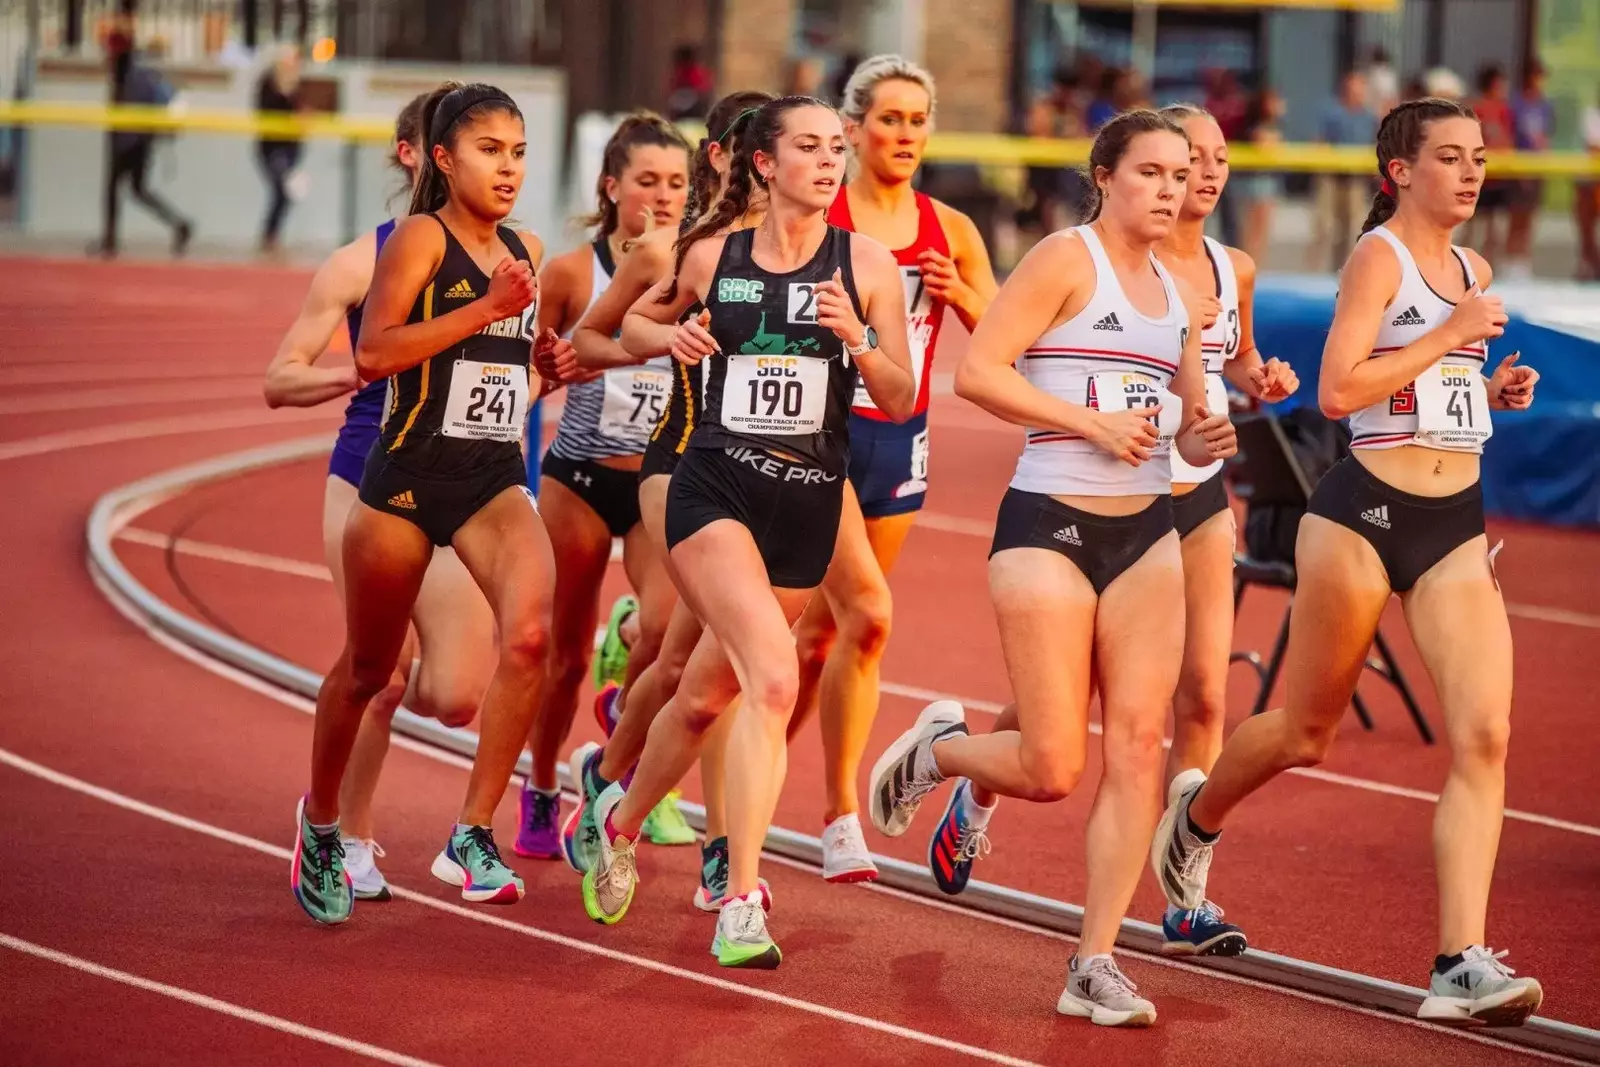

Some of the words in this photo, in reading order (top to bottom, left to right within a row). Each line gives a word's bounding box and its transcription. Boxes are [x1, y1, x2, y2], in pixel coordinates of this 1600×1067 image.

[718, 278, 764, 303] SBC
[795, 284, 818, 321] 2
[1092, 323, 1124, 332] adidas
[1225, 309, 1238, 355] 3
[1392, 318, 1426, 327] adidas
[481, 365, 512, 386] SBC
[757, 357, 798, 377] SBC
[1441, 367, 1472, 387] SBC
[466, 387, 516, 425] 241
[629, 392, 662, 424] 75
[748, 379, 803, 417] 190
[1446, 390, 1474, 428] 41
[747, 424, 796, 432] CHAMPIONSHIPS
[388, 499, 417, 510] adidas
[1361, 512, 1391, 529] adidas
[1053, 532, 1082, 547] adidas
